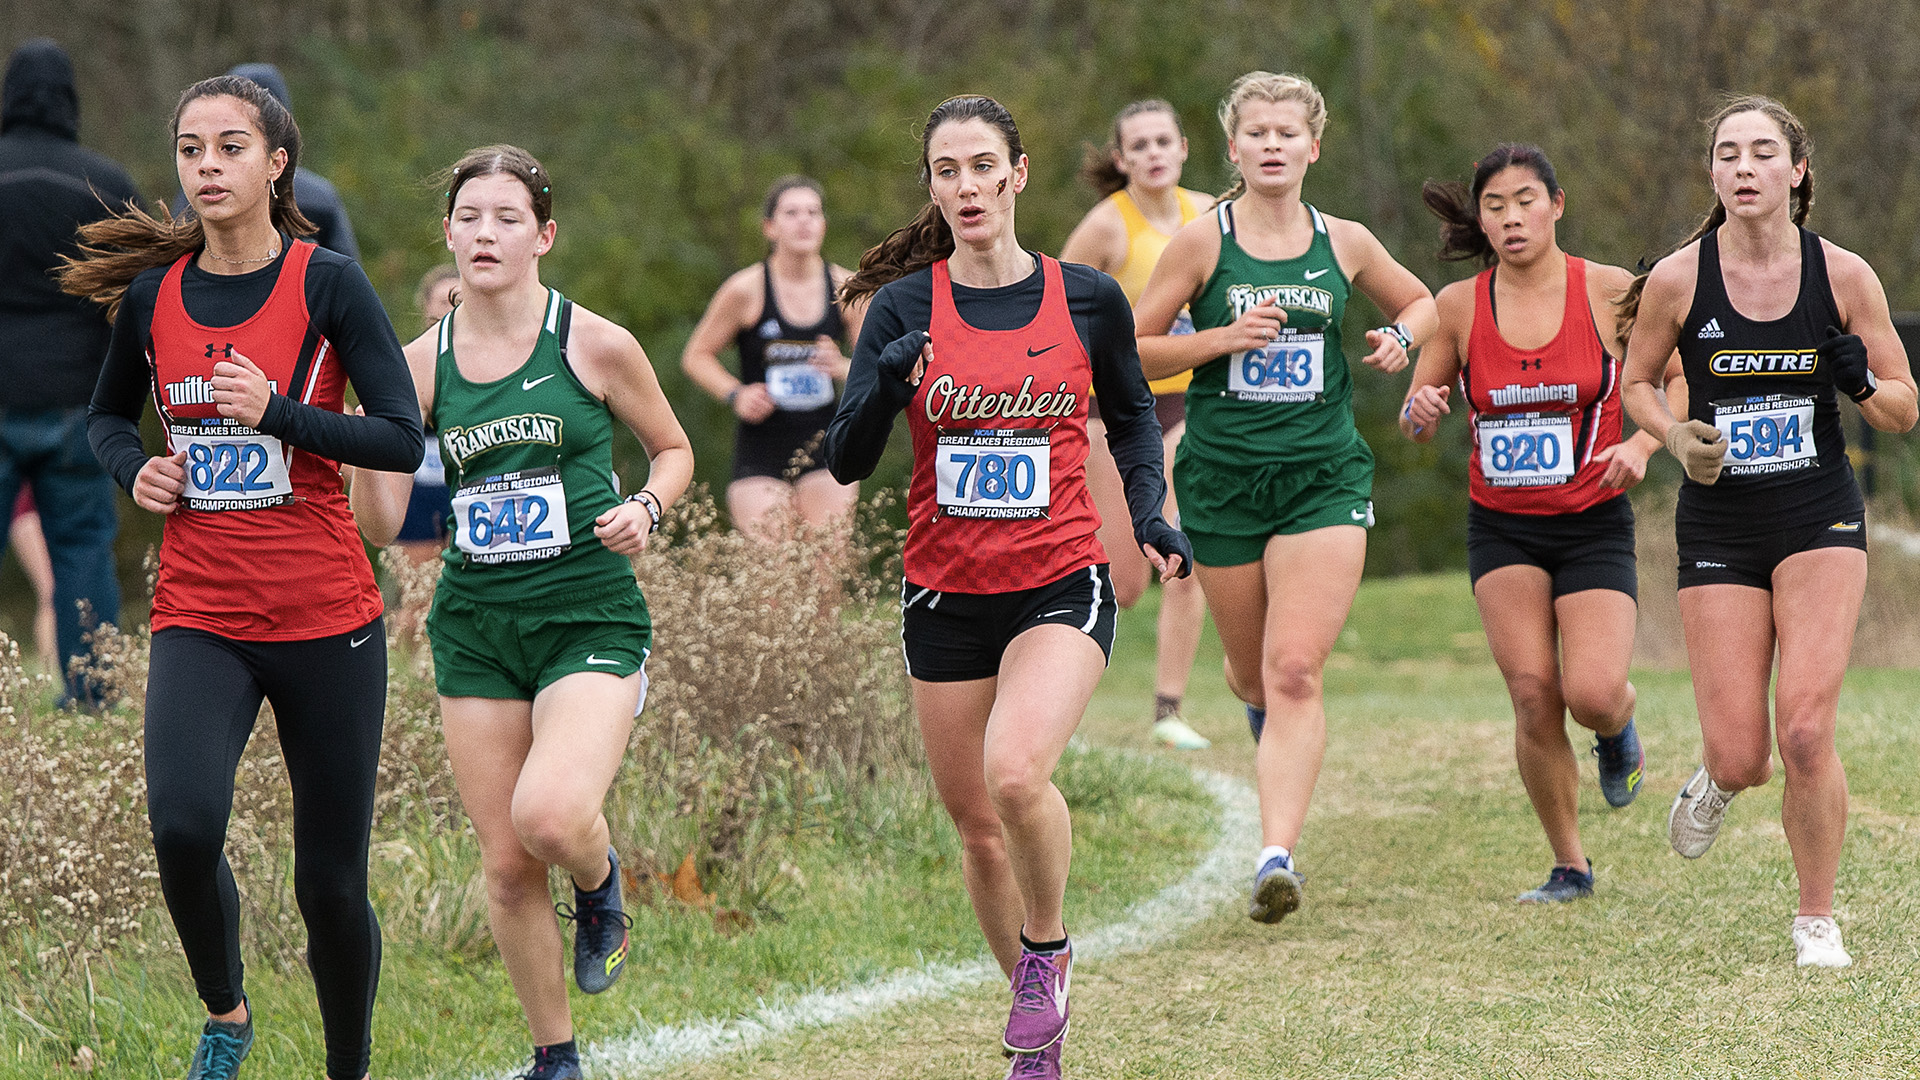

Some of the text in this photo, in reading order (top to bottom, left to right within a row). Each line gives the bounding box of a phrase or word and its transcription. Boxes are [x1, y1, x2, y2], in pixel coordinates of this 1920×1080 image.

[1698, 330, 1725, 339] adidas
[1242, 348, 1313, 387] 643
[1711, 353, 1816, 374] CENTRE
[925, 374, 1078, 424] Otterbein
[1238, 391, 1316, 402] CHAMPIONSHIPS
[1746, 396, 1765, 404] NCAA
[1716, 398, 1815, 415] GREAT LAKES REGIONAL
[171, 425, 261, 435] GREAT LAKES REGI
[201, 418, 220, 426] NCAA
[1479, 416, 1572, 429] GREAT LAKES REGIONAL
[443, 416, 557, 469] FRANCISCAN
[938, 436, 1050, 446] GREAT LAKES REGIONAL
[1730, 413, 1804, 460] 594
[1490, 432, 1561, 472] 820
[188, 442, 274, 492] 822
[1732, 457, 1811, 475] CHAMPIONSHIPS
[455, 473, 562, 498] GREAT LAKES REGIONAL
[950, 454, 1036, 500] 780
[1493, 475, 1568, 487] CHAMPIONSHIPS
[190, 496, 284, 511] CHAMPIONSHIPS
[947, 506, 1041, 519] CHAMPIONSHIPS
[467, 494, 554, 547] 642
[471, 546, 562, 565] CHAMPIONSHIPS
